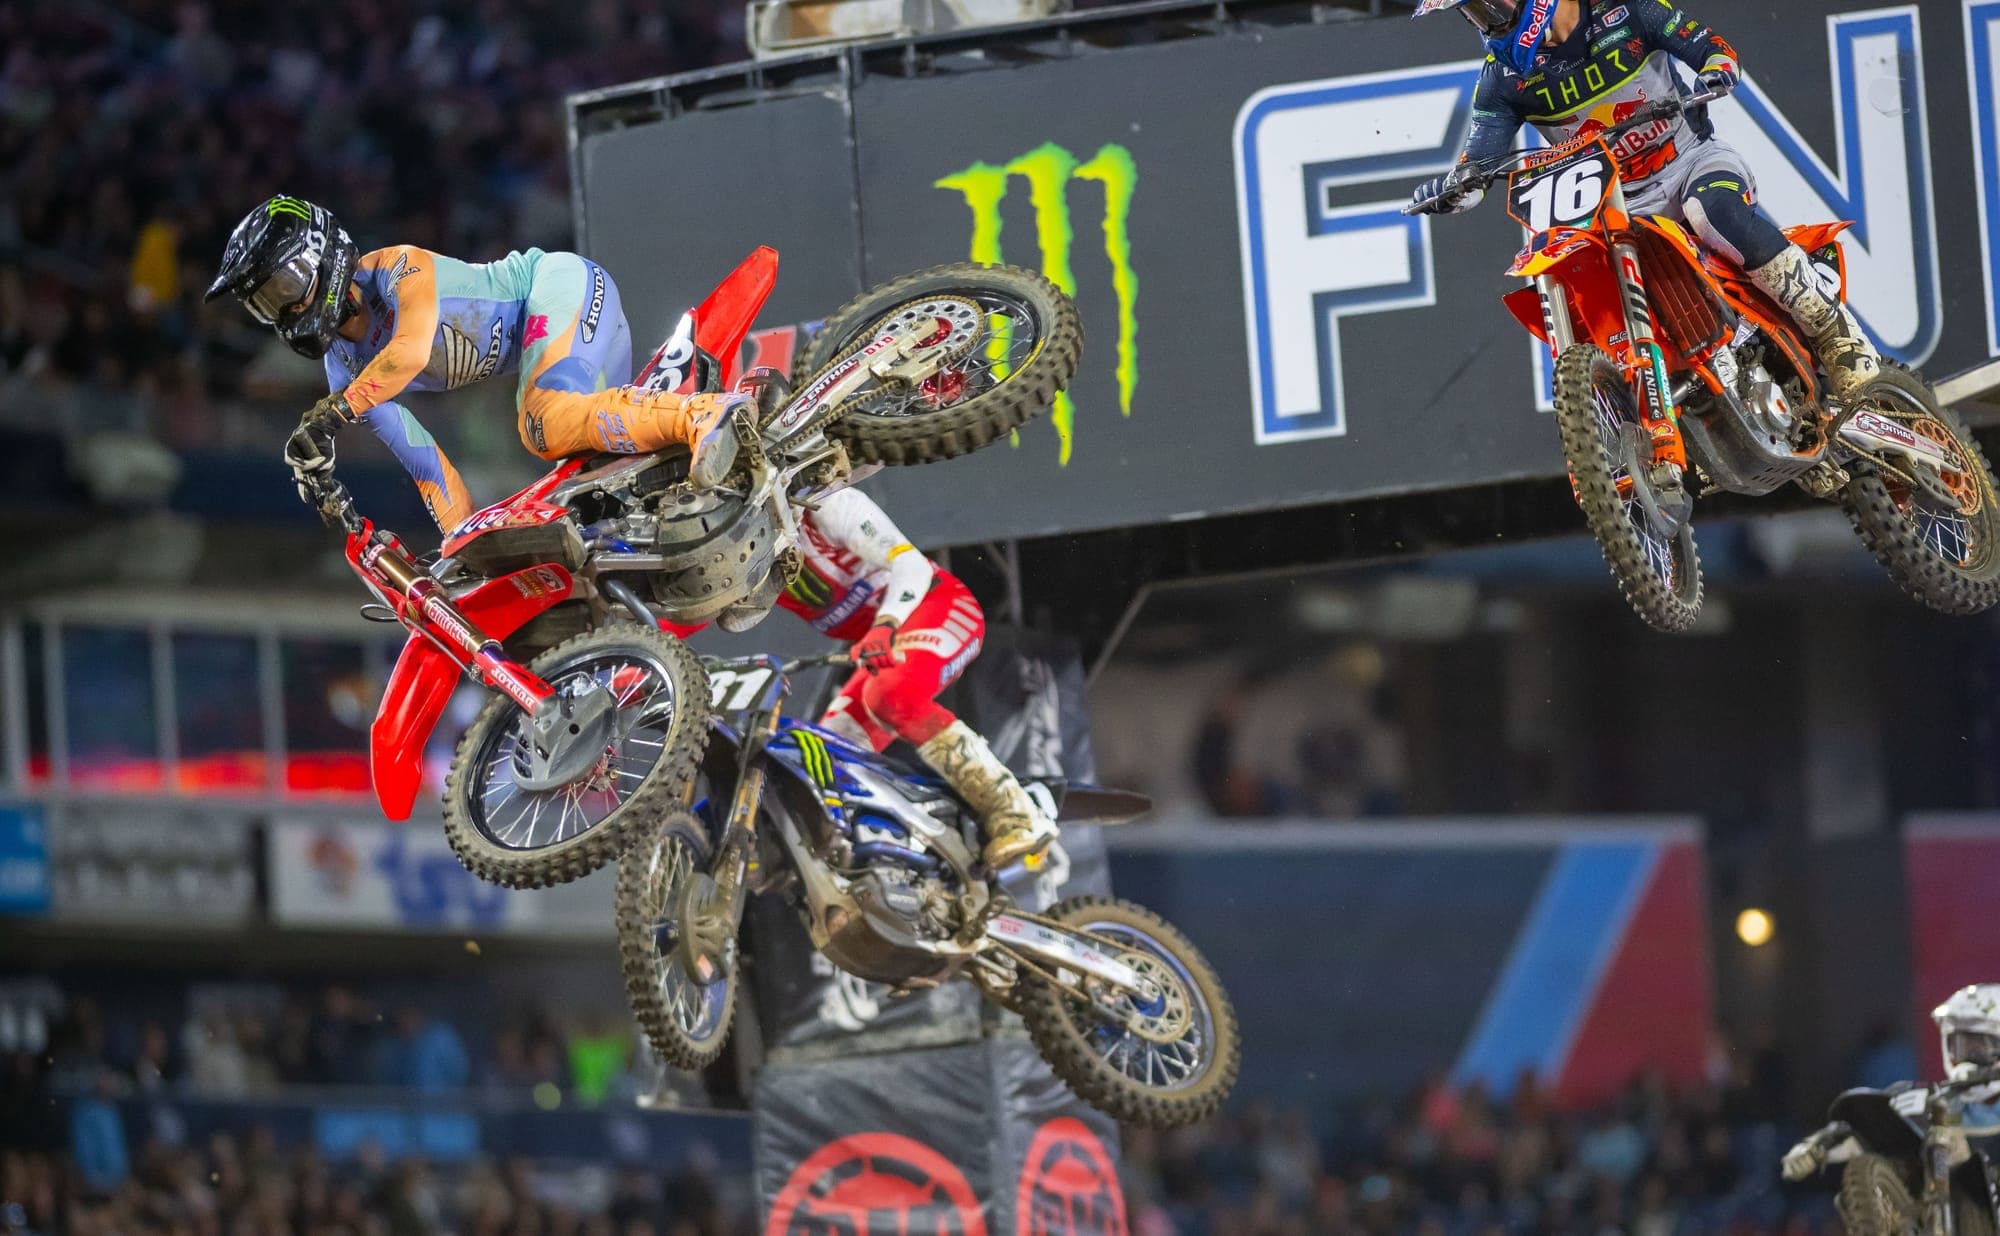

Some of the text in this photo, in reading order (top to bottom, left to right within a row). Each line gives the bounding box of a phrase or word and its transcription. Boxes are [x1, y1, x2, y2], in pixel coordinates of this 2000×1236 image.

[1518, 8, 1550, 48] Red
[1607, 8, 1627, 25] 100%
[1624, 118, 1670, 152] Bull
[1518, 158, 1604, 234] 16
[587, 266, 606, 328] HONDA
[822, 584, 873, 631] YAMAHA
[491, 667, 535, 708] DUNLOP
